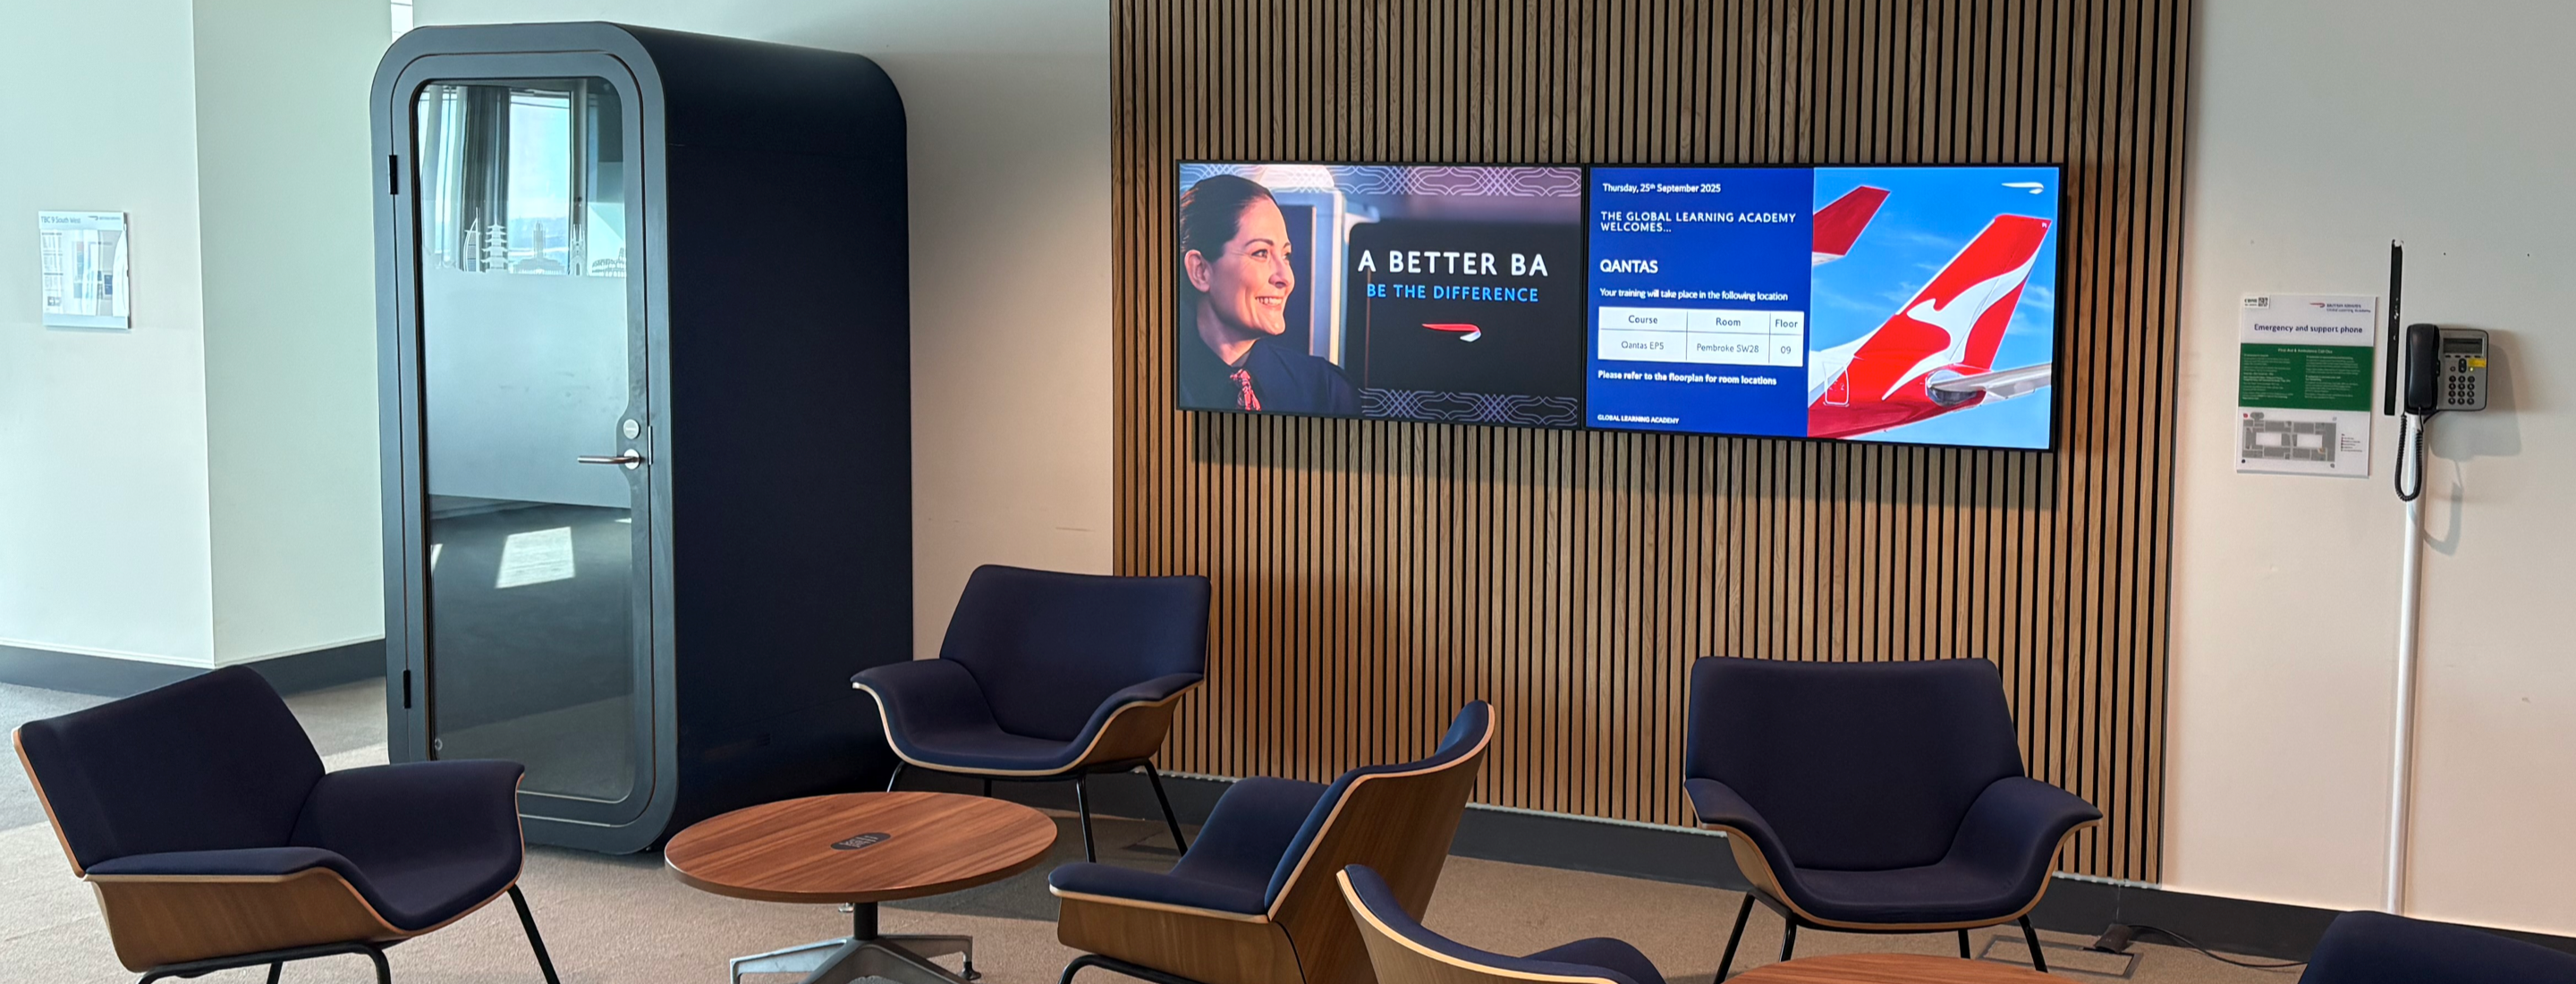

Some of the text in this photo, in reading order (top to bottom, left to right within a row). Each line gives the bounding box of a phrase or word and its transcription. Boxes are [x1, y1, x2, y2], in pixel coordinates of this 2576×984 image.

[1602, 182, 1639, 193] Thursday,
[1657, 183, 1699, 194] September
[1699, 183, 1721, 193] 2025
[1600, 211, 1797, 224] THE GLOBAL LEARNING ACADEMY
[1357, 250, 1548, 276] A BETTER BA
[1599, 259, 1658, 274] QANTAS
[1367, 284, 1538, 302] BE THE DIFFERENCE
[1599, 287, 1788, 302] Your training will take place in the following location
[1628, 315, 1799, 328] Course Room Floor
[2254, 323, 2363, 335] Emergency and support phone
[1696, 344, 1734, 352] Pembroke
[1780, 345, 1792, 354] 09
[1597, 369, 1776, 386] Please refer to the floorplan for room locations
[1597, 413, 1680, 424] GLOBAL LEARNING ACADEMY
